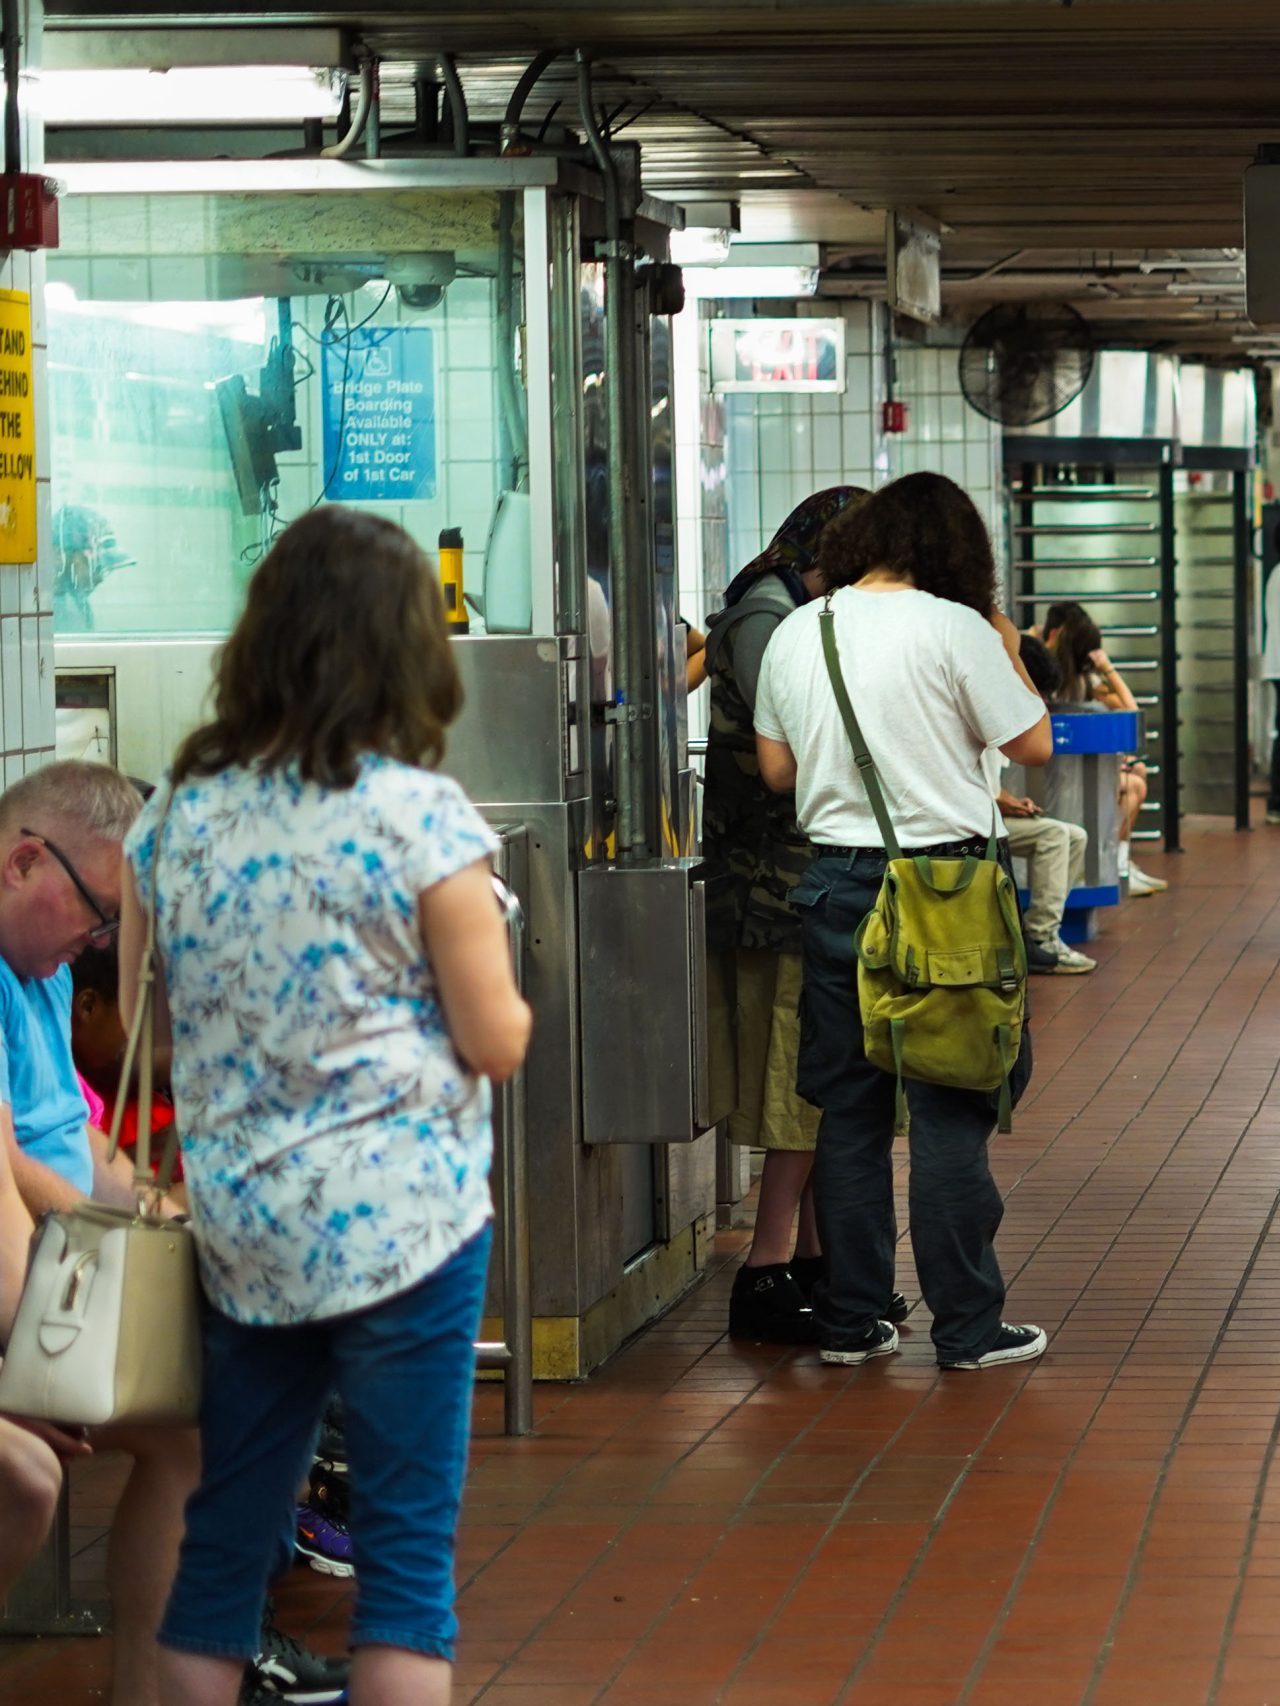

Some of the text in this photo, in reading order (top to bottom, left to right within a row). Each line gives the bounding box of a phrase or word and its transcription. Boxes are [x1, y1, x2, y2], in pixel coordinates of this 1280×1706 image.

[0, 328, 26, 357] TAND
[0, 369, 29, 398] EHIND
[333, 380, 423, 397] Bridge Plate
[344, 398, 412, 414] Boarding
[0, 411, 21, 439] THE
[346, 416, 412, 428] Available
[346, 432, 412, 446] ONLY at:
[349, 449, 411, 463] 1st Door
[0, 452, 33, 481] ELLOW
[343, 467, 416, 481] of 1st Car
